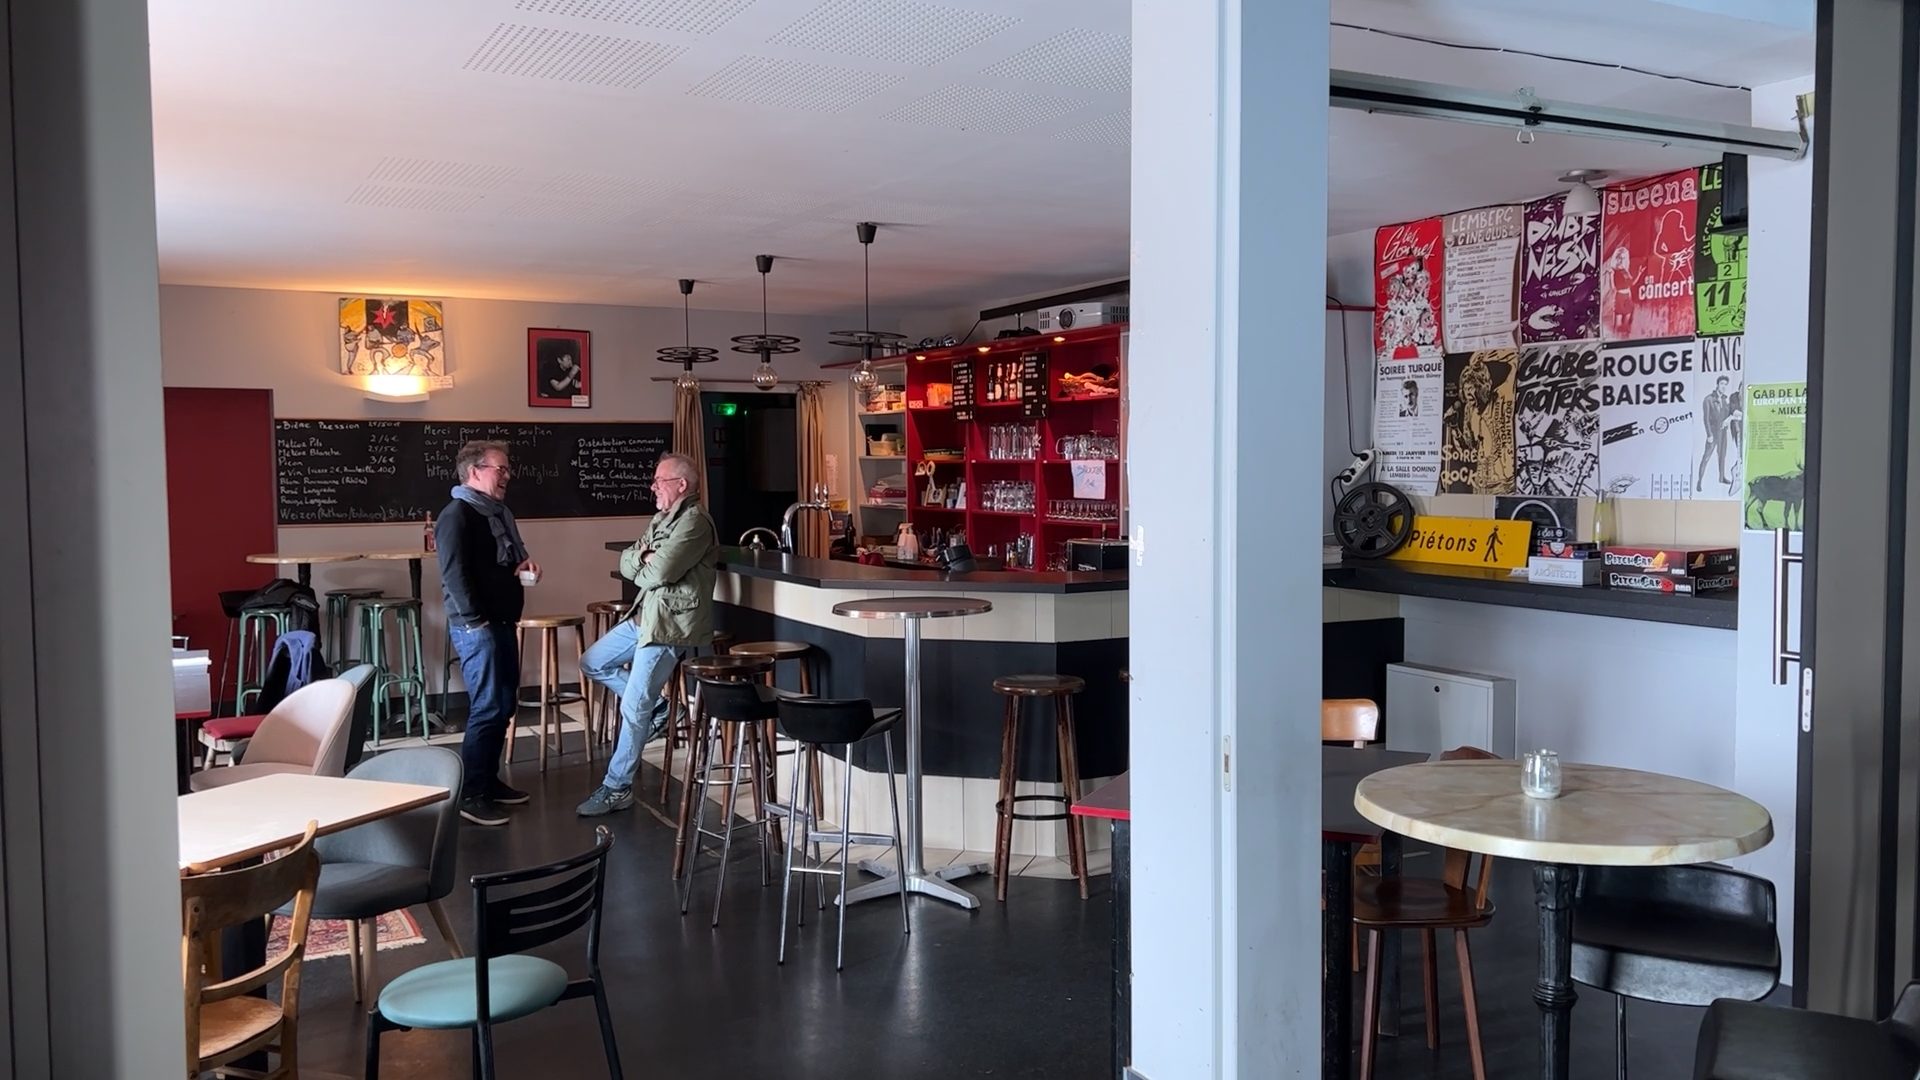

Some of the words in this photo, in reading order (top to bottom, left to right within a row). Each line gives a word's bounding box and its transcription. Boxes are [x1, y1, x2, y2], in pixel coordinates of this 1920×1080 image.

[1606, 175, 1698, 216] sheena
[1451, 206, 1514, 233] LEMBERG
[1723, 264, 1732, 277] 2
[1638, 277, 1695, 301] concert
[1703, 281, 1732, 308] 11
[1407, 362, 1443, 374] TURQUE
[1602, 349, 1693, 378] ROUGE
[1602, 381, 1686, 407] BAISER
[1752, 389, 1776, 400] GAB
[1778, 388, 1793, 399] DE
[1777, 406, 1802, 416] MIKE
[423, 425, 450, 436] Merci
[518, 425, 553, 436] soutien
[443, 435, 468, 450] peupl
[578, 456, 590, 469] Le
[1411, 465, 1437, 473] DOMINO
[1407, 529, 1478, 553] Piétons
